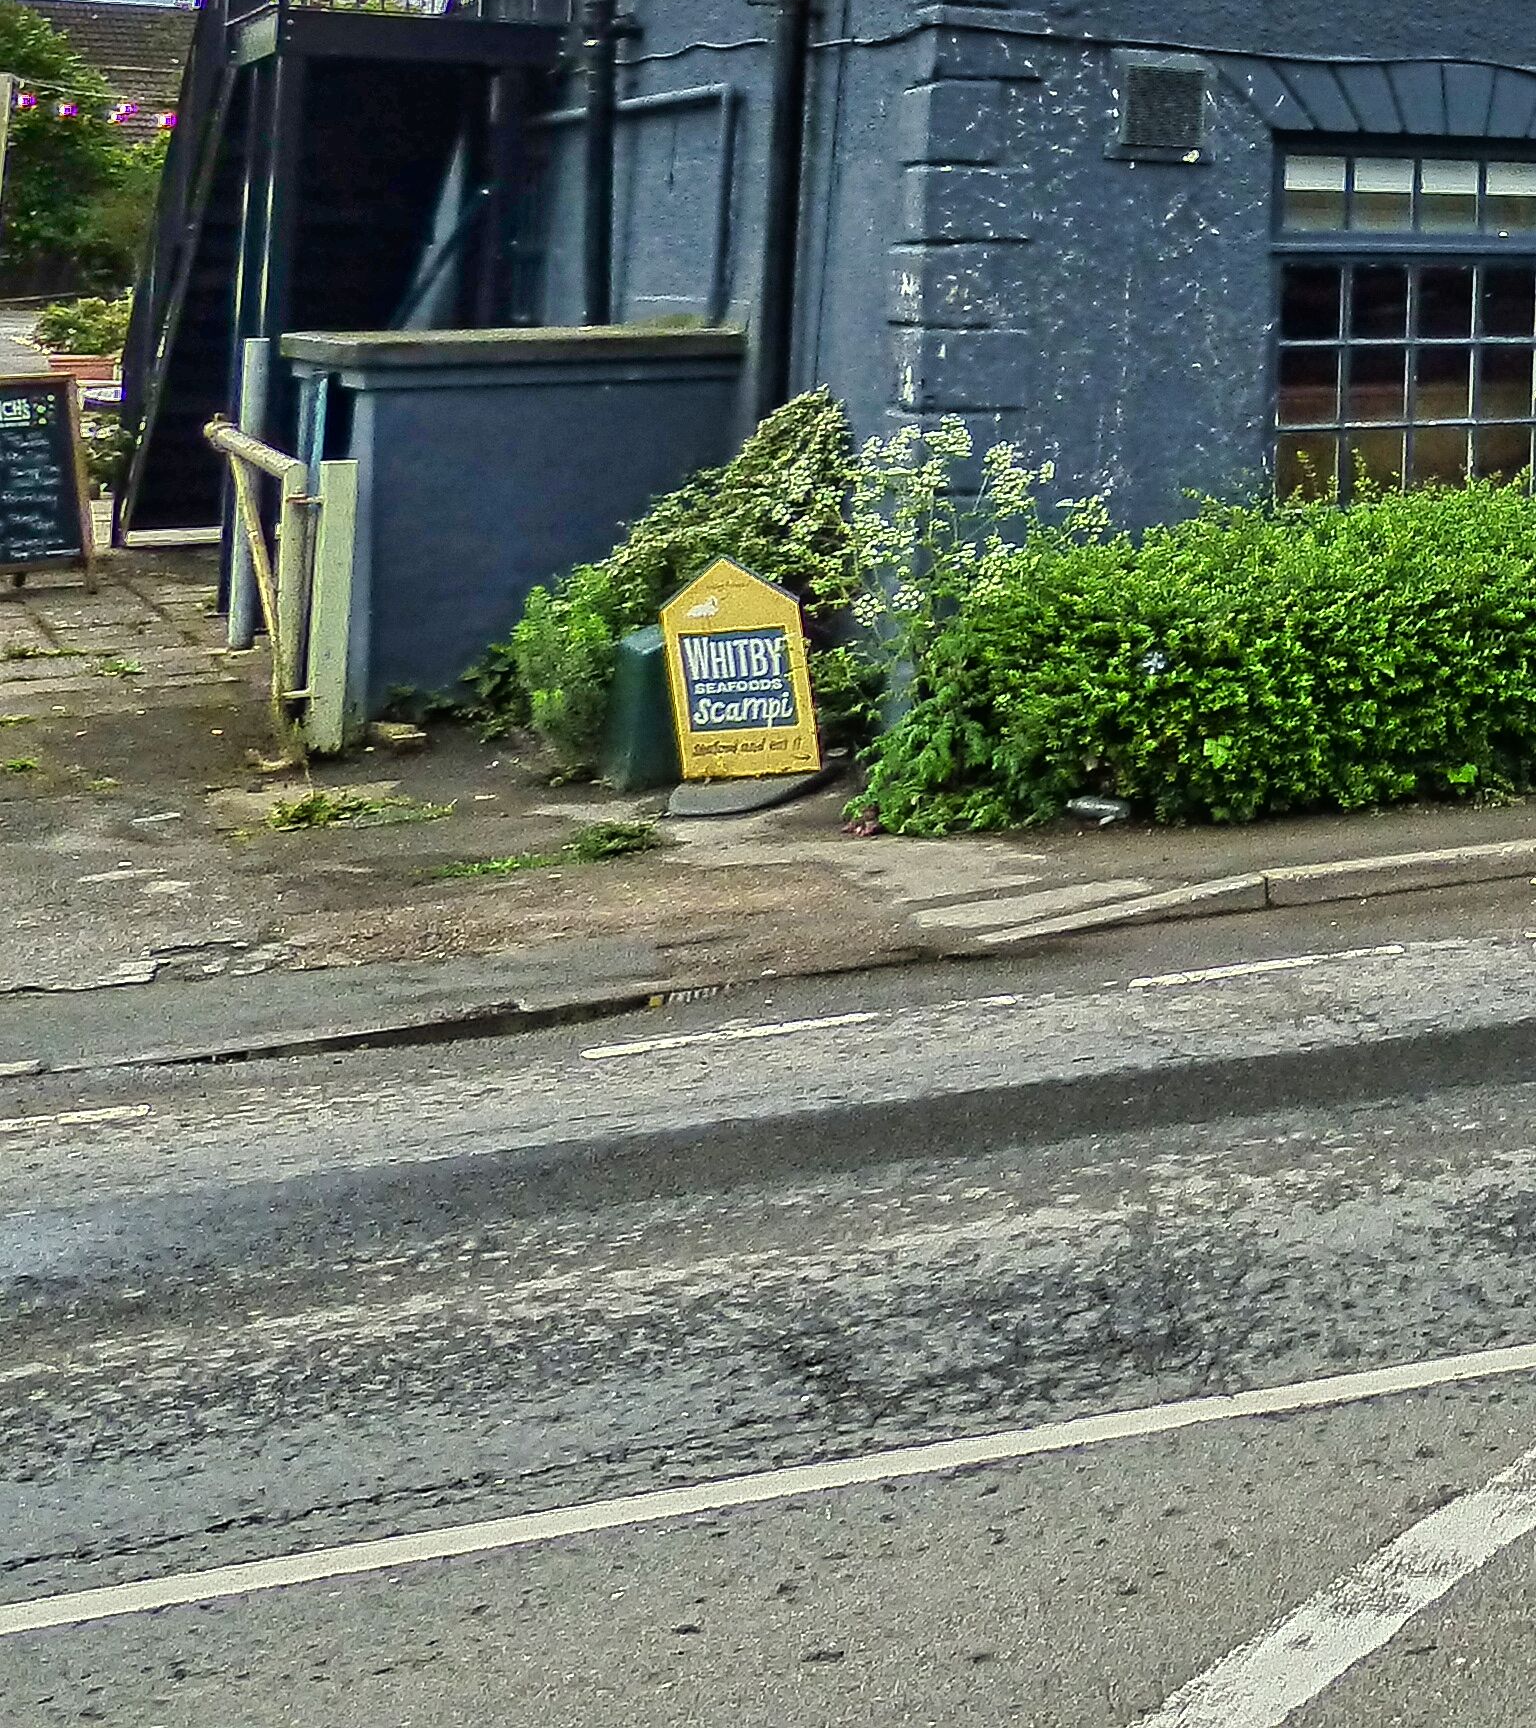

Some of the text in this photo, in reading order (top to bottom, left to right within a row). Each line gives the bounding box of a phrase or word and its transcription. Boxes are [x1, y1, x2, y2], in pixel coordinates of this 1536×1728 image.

[682, 635, 786, 681] WHITBY
[694, 677, 784, 695] SEAFOODS
[693, 691, 794, 728] Scampi
